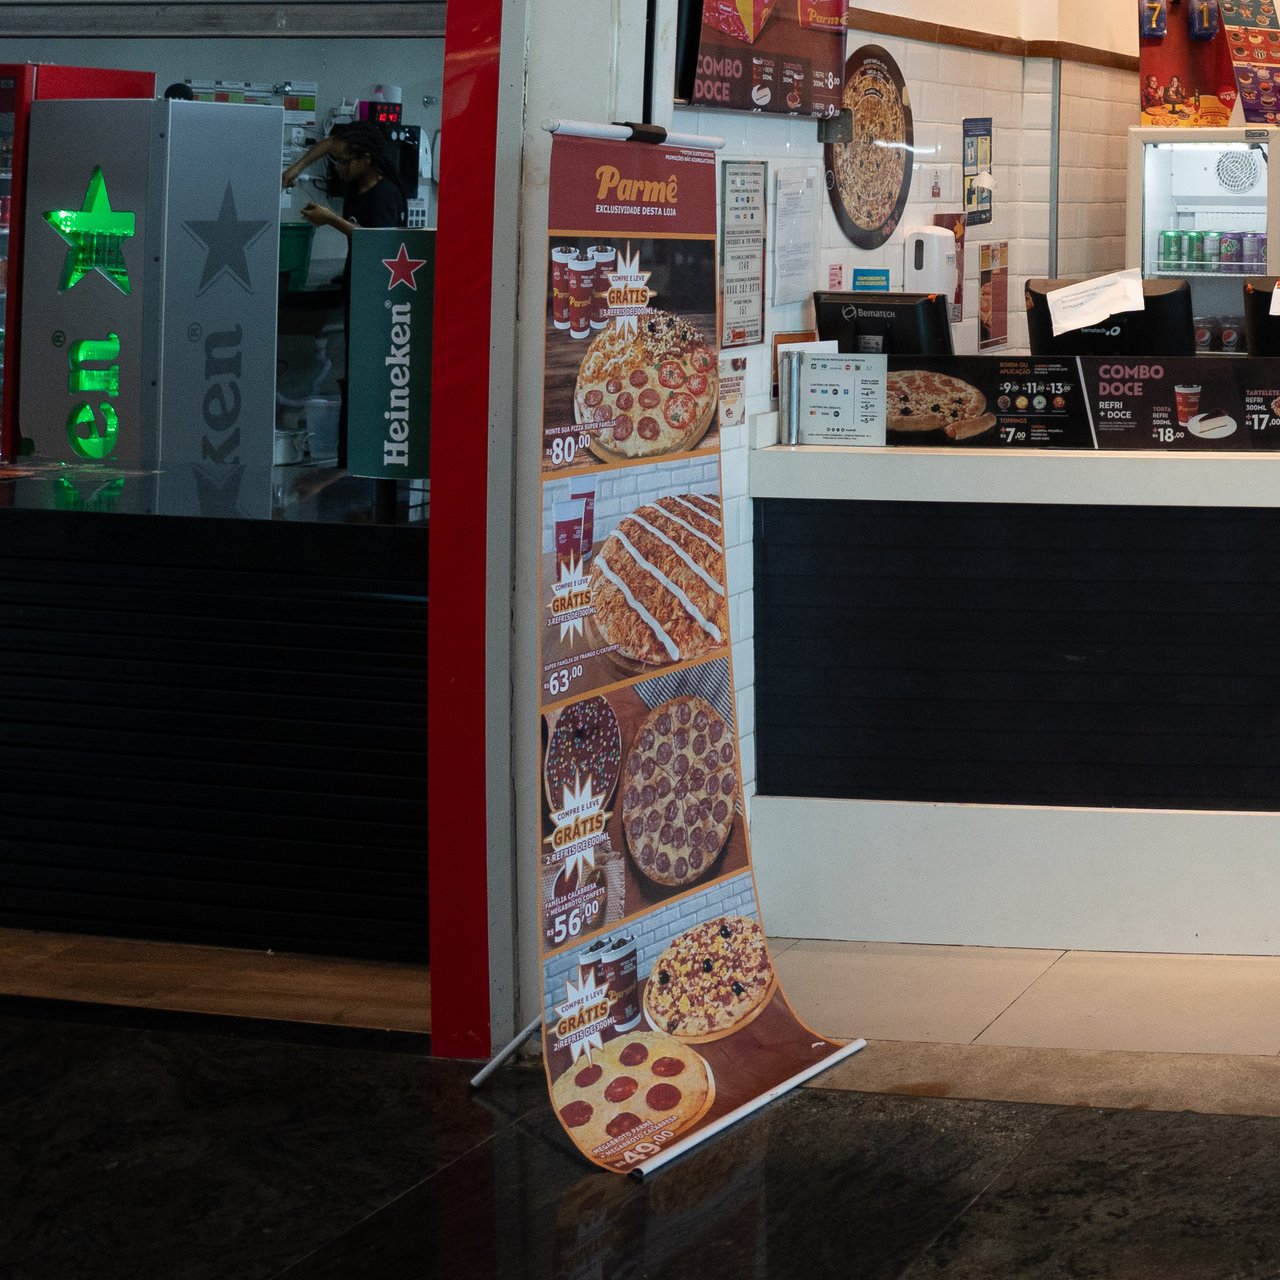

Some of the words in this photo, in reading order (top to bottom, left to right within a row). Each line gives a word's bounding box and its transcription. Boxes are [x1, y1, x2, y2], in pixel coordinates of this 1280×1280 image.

[1148, 3, 1162, 29] 7
[1200, 2, 1209, 28] 1
[697, 55, 742, 78] COMBO
[694, 80, 730, 101] DOCE
[596, 165, 678, 203] Parmê
[596, 204, 640, 215] EXCLUSIVIDADE
[642, 207, 662, 215] DESTA
[664, 208, 677, 216] LOJA
[608, 286, 648, 305] GRÁTIS
[1099, 365, 1164, 379] COMBO
[384, 302, 412, 467] Heineken
[1099, 382, 1143, 396] DOCE
[1099, 401, 1123, 409] REFRI
[1108, 411, 1131, 419] DOCE
[583, 423, 598, 431] SUPER
[599, 420, 616, 429] FAMÍLIA
[1252, 414, 1280, 430] 17,00
[1158, 428, 1184, 442] 18,00
[552, 434, 590, 465] 80,00
[555, 581, 573, 591] COMPRE
[577, 577, 588, 586] LEVE
[552, 588, 591, 614] GRÁTIS
[549, 665, 582, 696] 63,00
[558, 806, 580, 821] COMPRE
[586, 799, 600, 810] LEVE
[554, 814, 603, 846] GRÁTIS
[552, 845, 576, 861] REFRIS
[545, 894, 567, 909] FAMÍLIA
[568, 882, 597, 901] CALABRESA
[550, 898, 583, 916] MEGABROTO
[583, 887, 606, 905] CONFETE
[554, 900, 599, 943] 56,00
[561, 997, 584, 1014] COMPRE
[590, 989, 604, 999] LEVE
[558, 1001, 608, 1036] GRÁTIS
[560, 1032, 584, 1048] REFRIS
[592, 1131, 632, 1156] MEGABROTO
[631, 1119, 653, 1136] PARMÊ
[623, 1129, 675, 1164] 49,00
